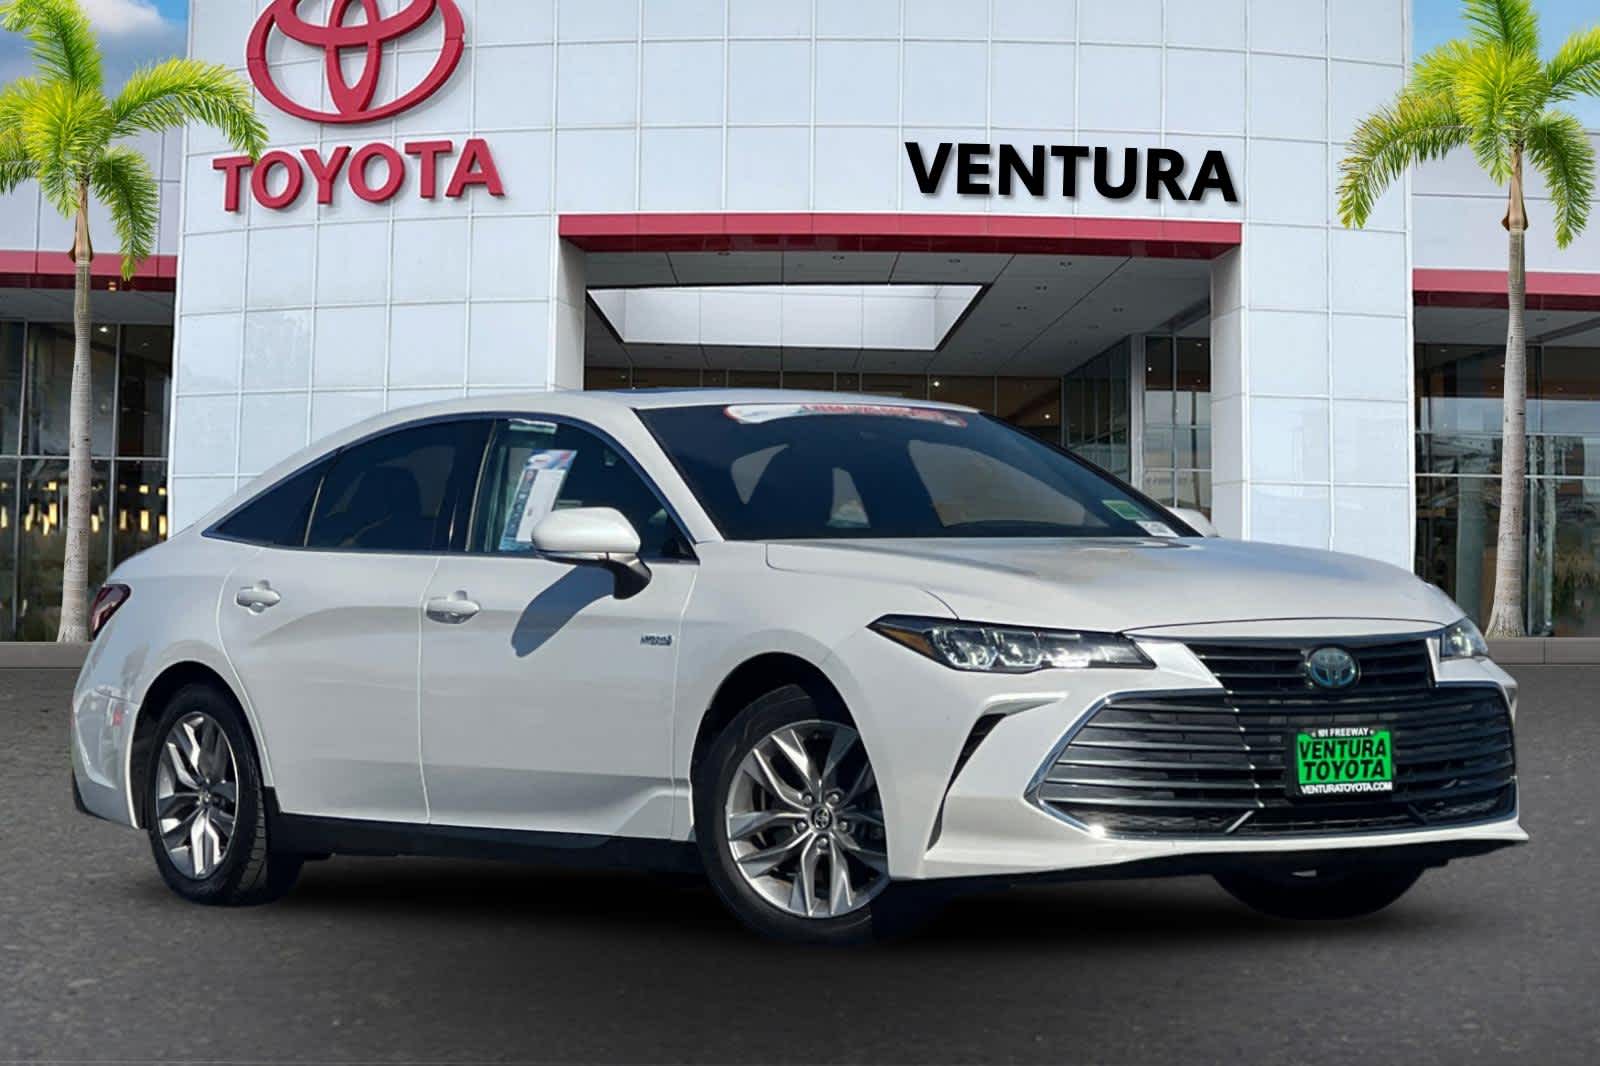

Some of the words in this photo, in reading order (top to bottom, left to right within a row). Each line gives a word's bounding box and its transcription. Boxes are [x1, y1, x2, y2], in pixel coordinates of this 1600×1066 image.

[212, 138, 505, 212] TOYOTA
[904, 142, 1238, 202] VENTURA
[1330, 728, 1369, 736] FREEWAY
[1299, 738, 1387, 760] VENTURA
[1303, 758, 1385, 781] TOYOTA
[1300, 782, 1393, 795] VENTURATOYOTA.COM
